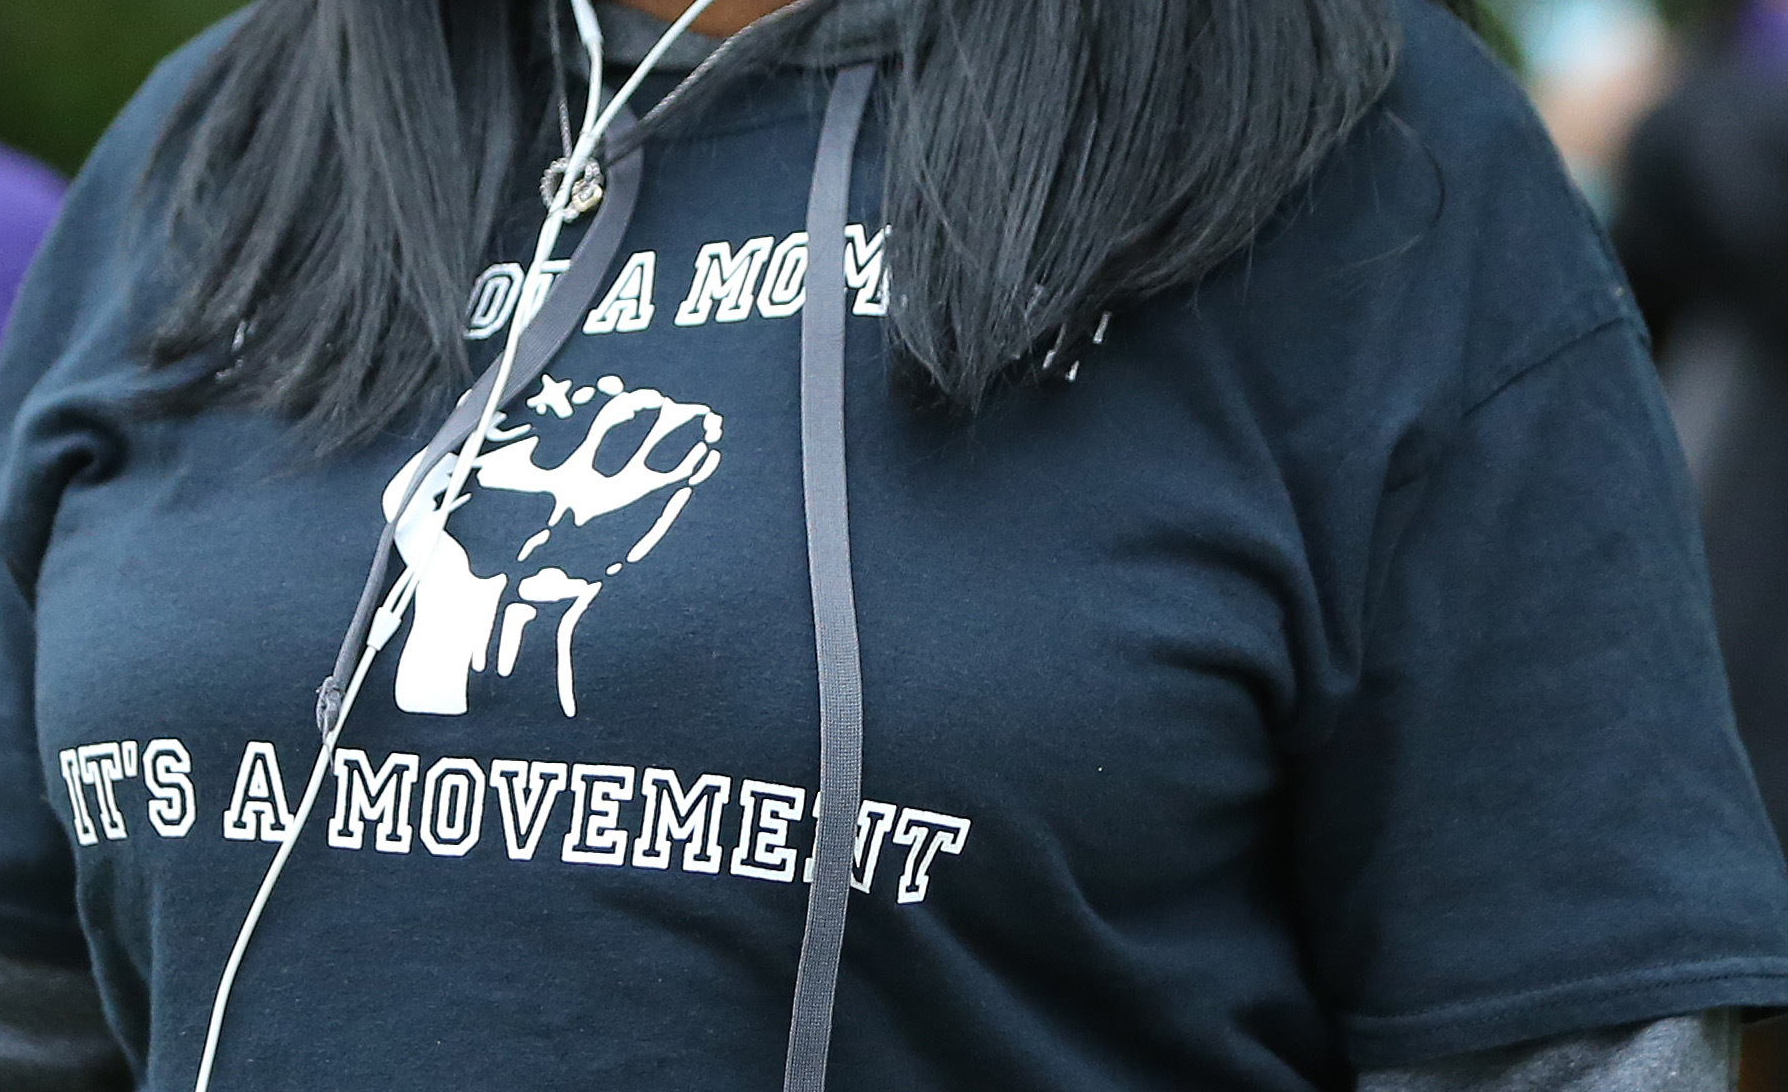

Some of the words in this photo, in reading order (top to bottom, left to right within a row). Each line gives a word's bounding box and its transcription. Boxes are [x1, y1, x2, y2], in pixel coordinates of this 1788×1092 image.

[582, 250, 657, 334] A
[59, 738, 197, 846] IT'S
[223, 741, 295, 842] A
